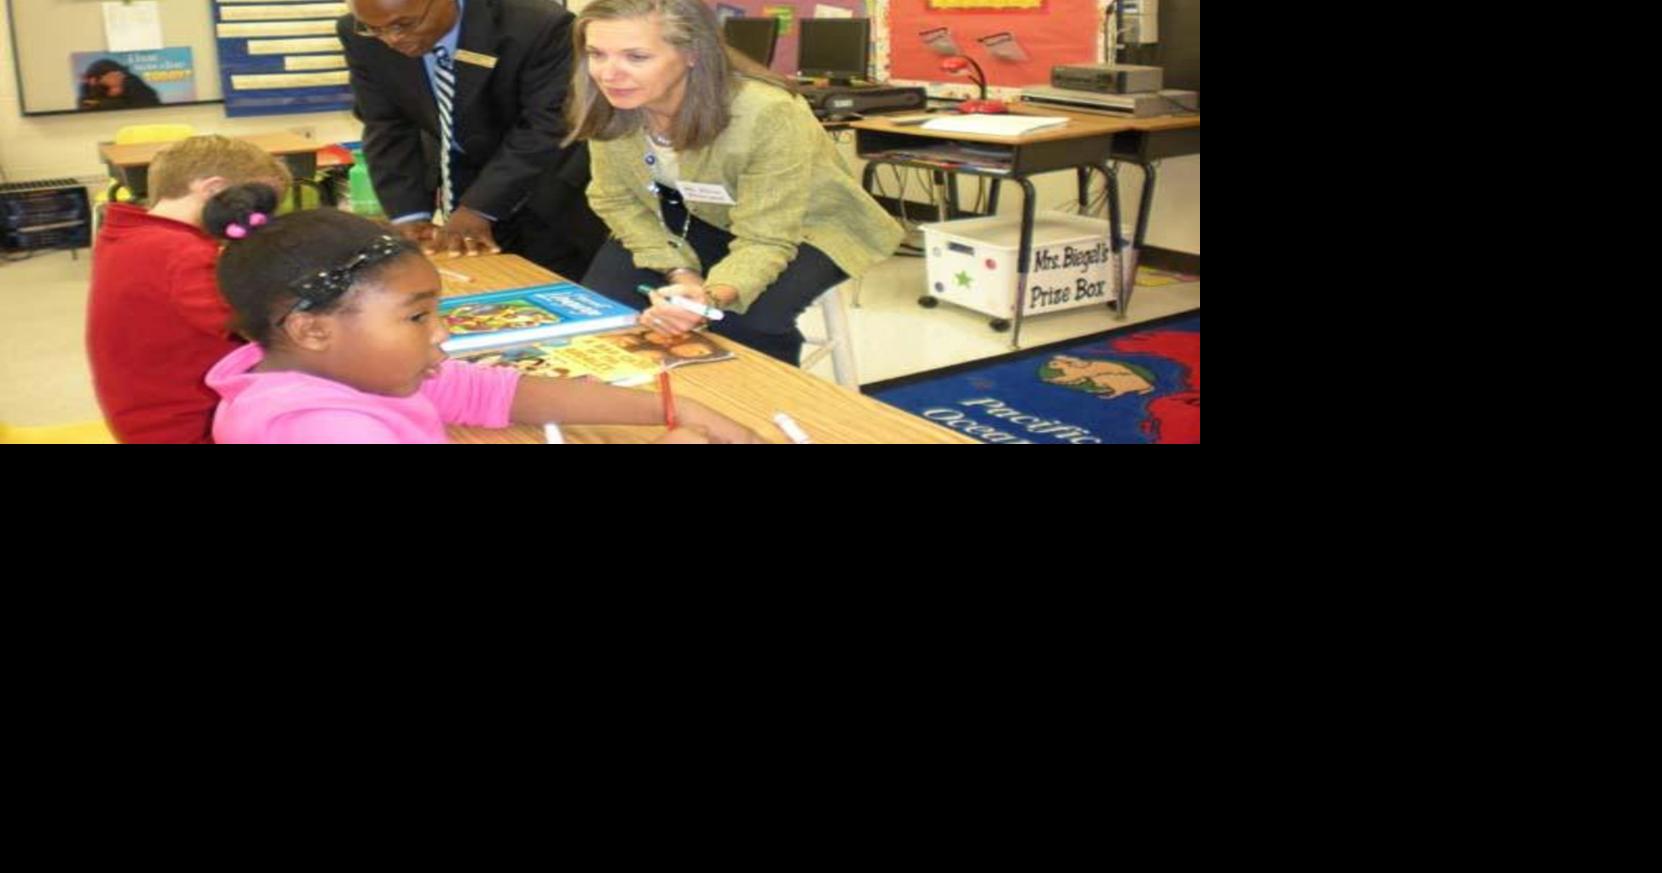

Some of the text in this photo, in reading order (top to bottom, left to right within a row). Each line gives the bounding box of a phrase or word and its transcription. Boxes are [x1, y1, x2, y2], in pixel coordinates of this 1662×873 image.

[1034, 243, 1109, 273] Mrs. Biegel's
[1030, 278, 1106, 308] Prize Box
[960, 397, 1102, 444] Pacific
